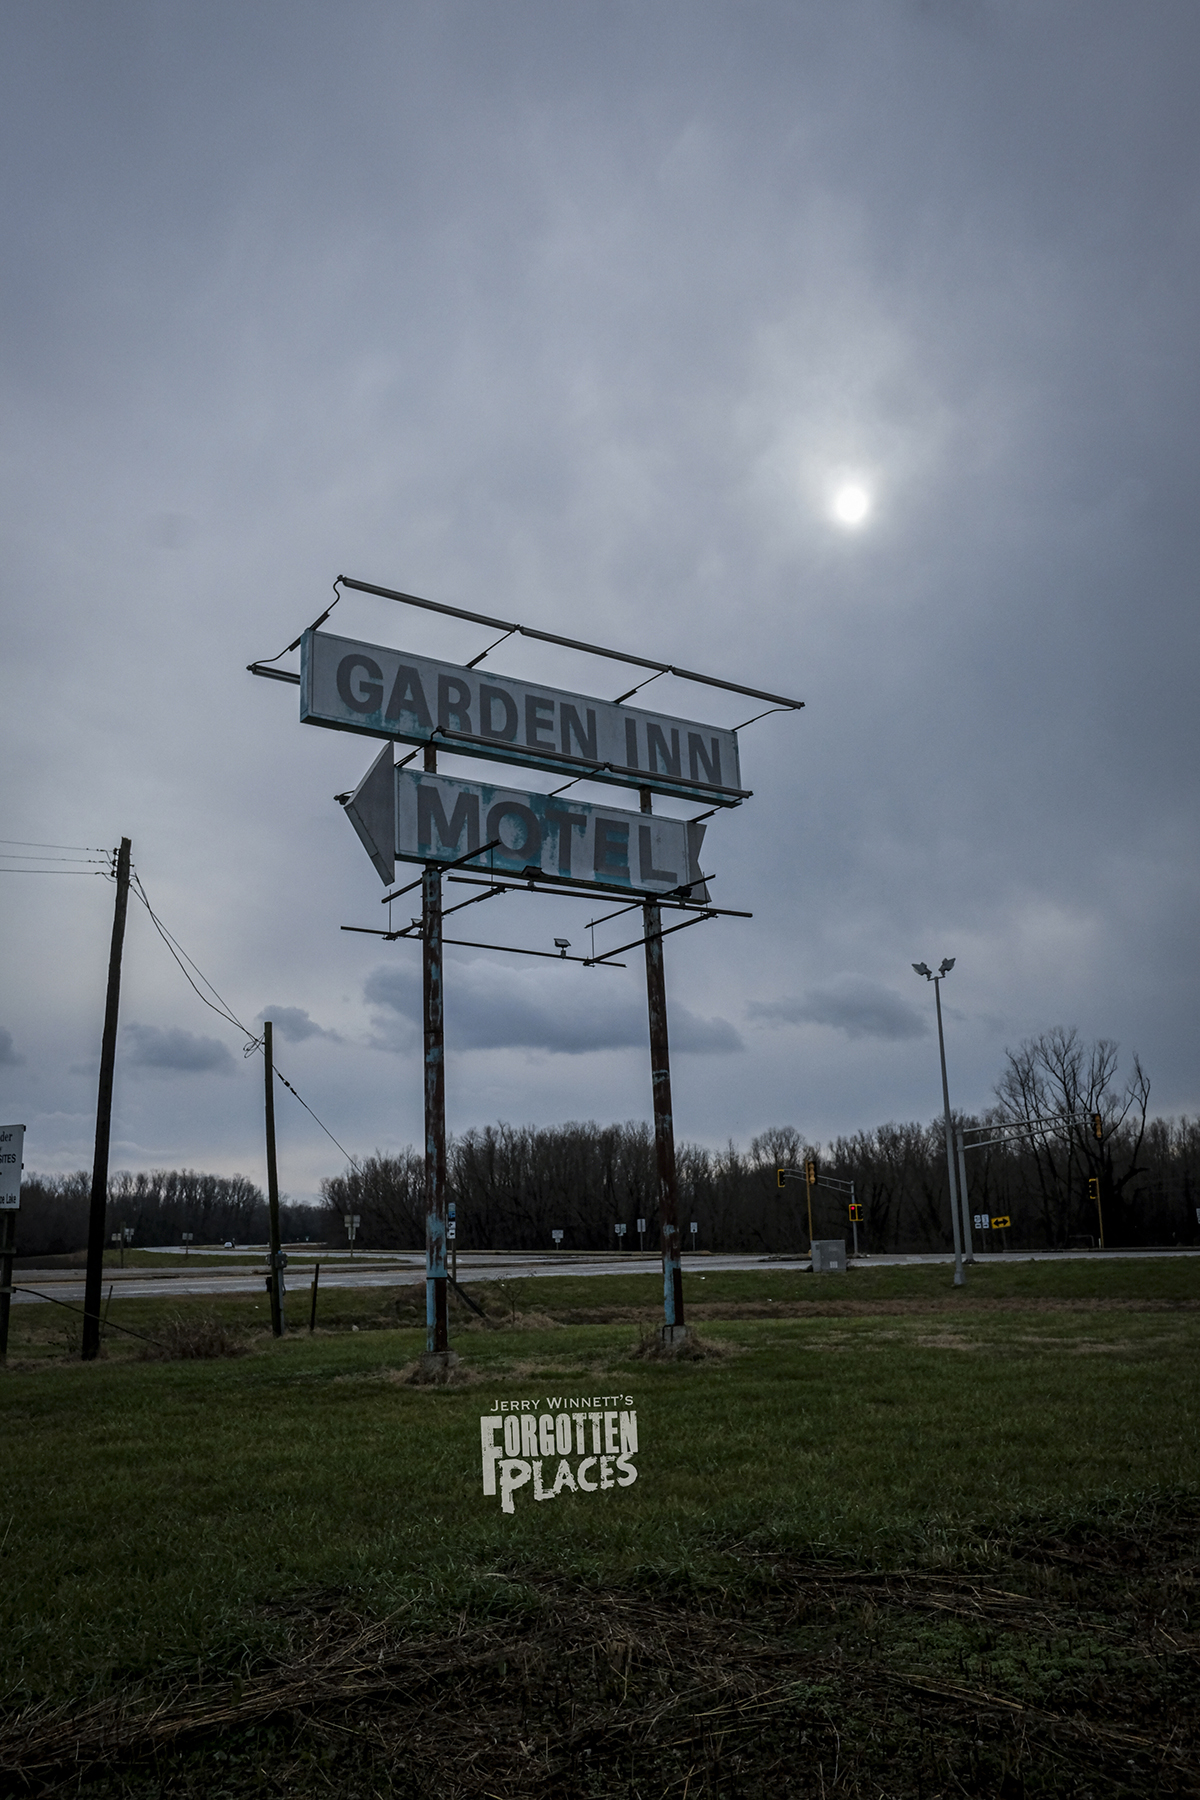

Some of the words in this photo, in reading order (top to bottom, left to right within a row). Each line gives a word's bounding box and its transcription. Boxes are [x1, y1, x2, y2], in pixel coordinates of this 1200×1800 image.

[335, 653, 598, 761] GARDEN
[624, 716, 723, 786] INN
[416, 784, 678, 884] MOTEL
